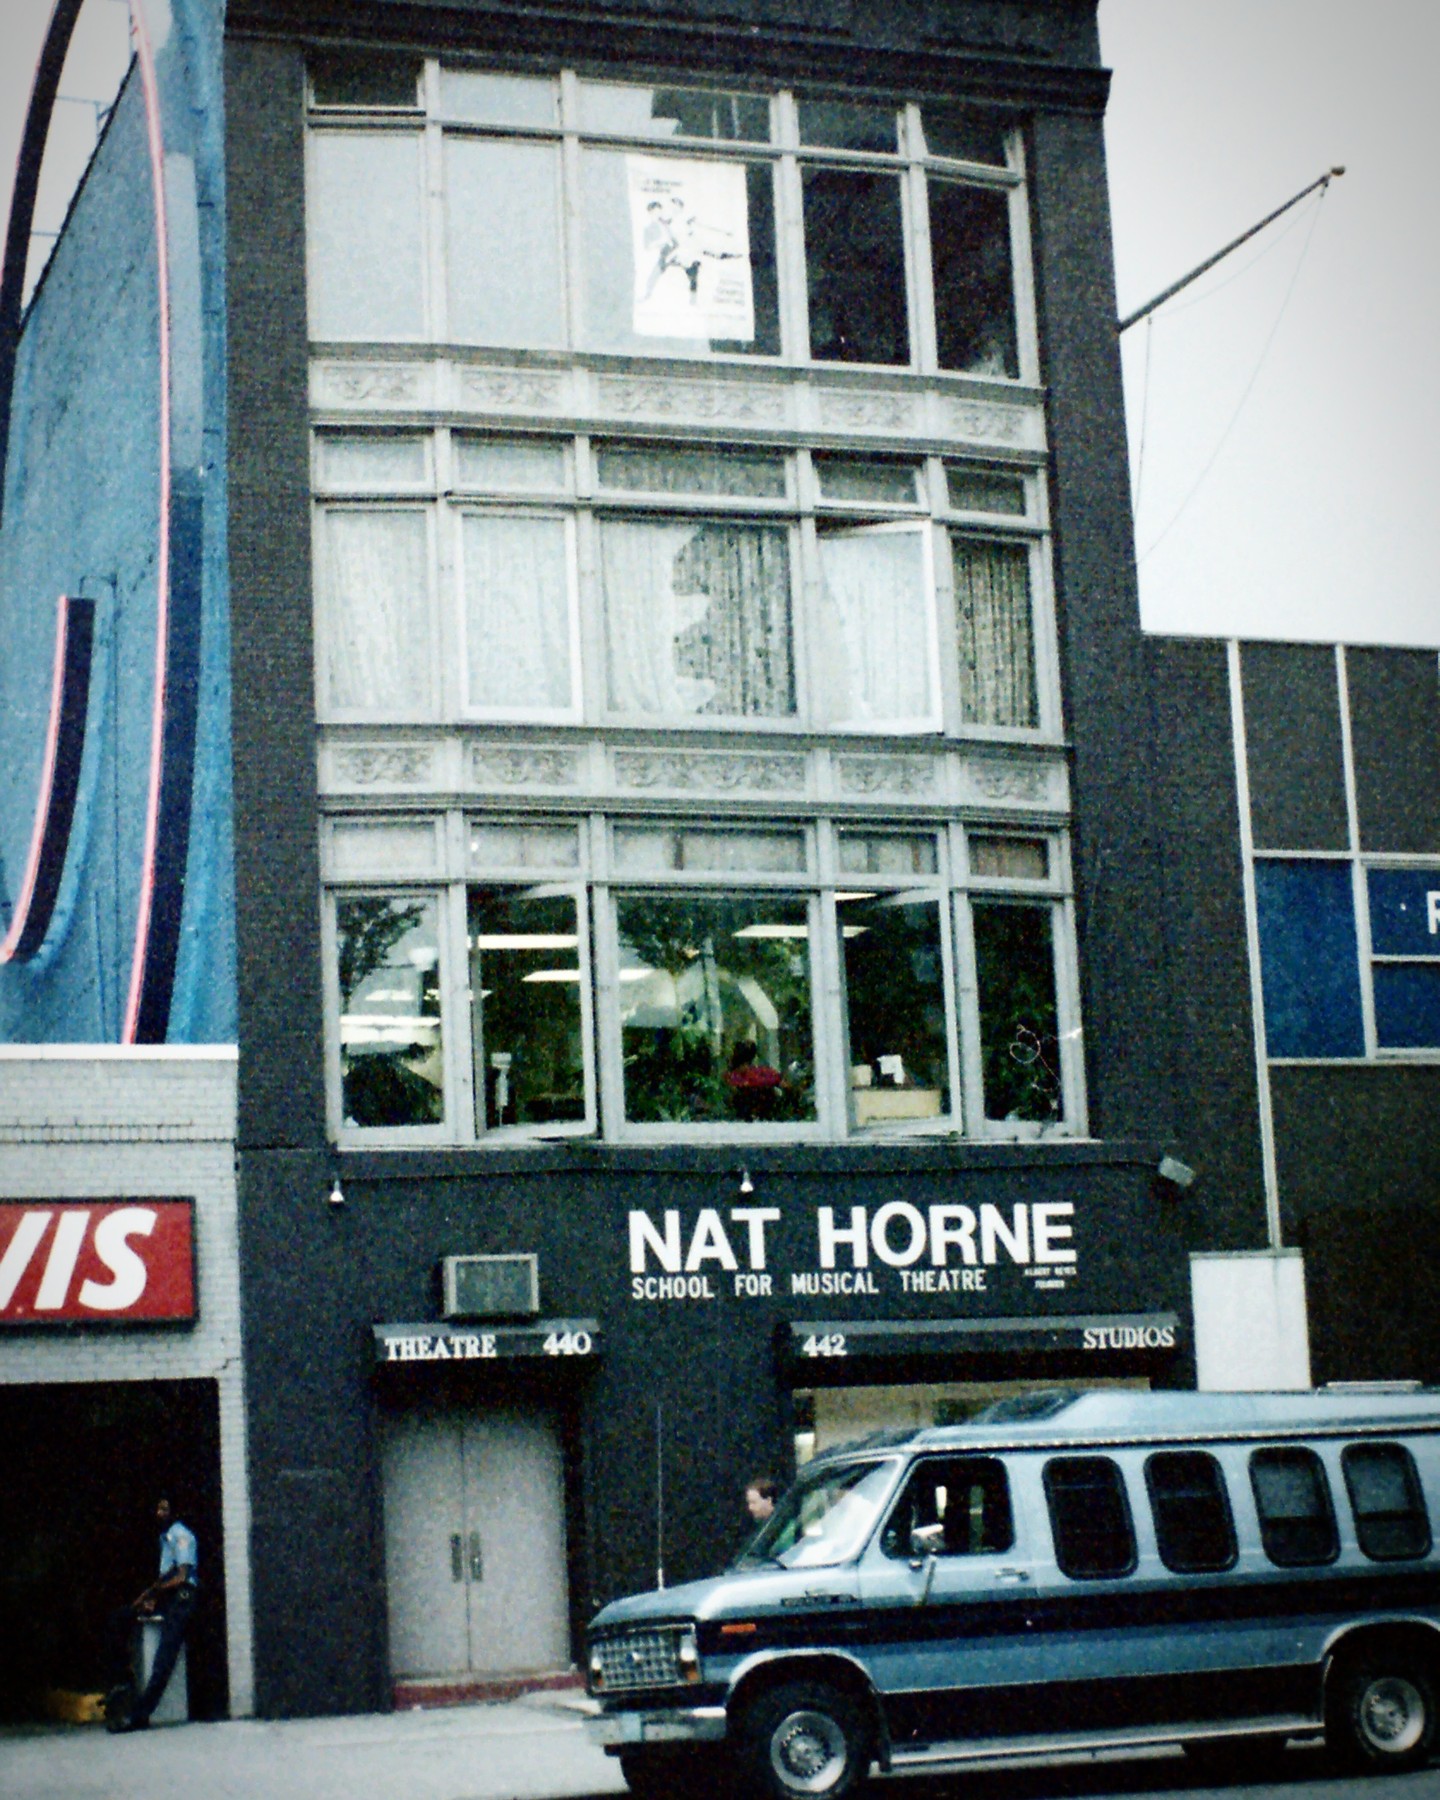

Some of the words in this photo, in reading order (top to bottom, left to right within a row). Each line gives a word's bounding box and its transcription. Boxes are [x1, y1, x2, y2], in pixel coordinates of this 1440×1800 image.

[629, 1208, 780, 1273] NAT
[817, 1201, 1077, 1266] HORNE
[631, 1276, 715, 1300] SCHOOL
[735, 1274, 772, 1296] FOR
[791, 1272, 879, 1295] MUSICAL
[901, 1269, 987, 1292] THEATRE
[384, 1334, 497, 1360] THEATRE
[543, 1332, 592, 1355] 440
[802, 1334, 848, 1357] 442
[1083, 1327, 1174, 1349] STUDIOS
